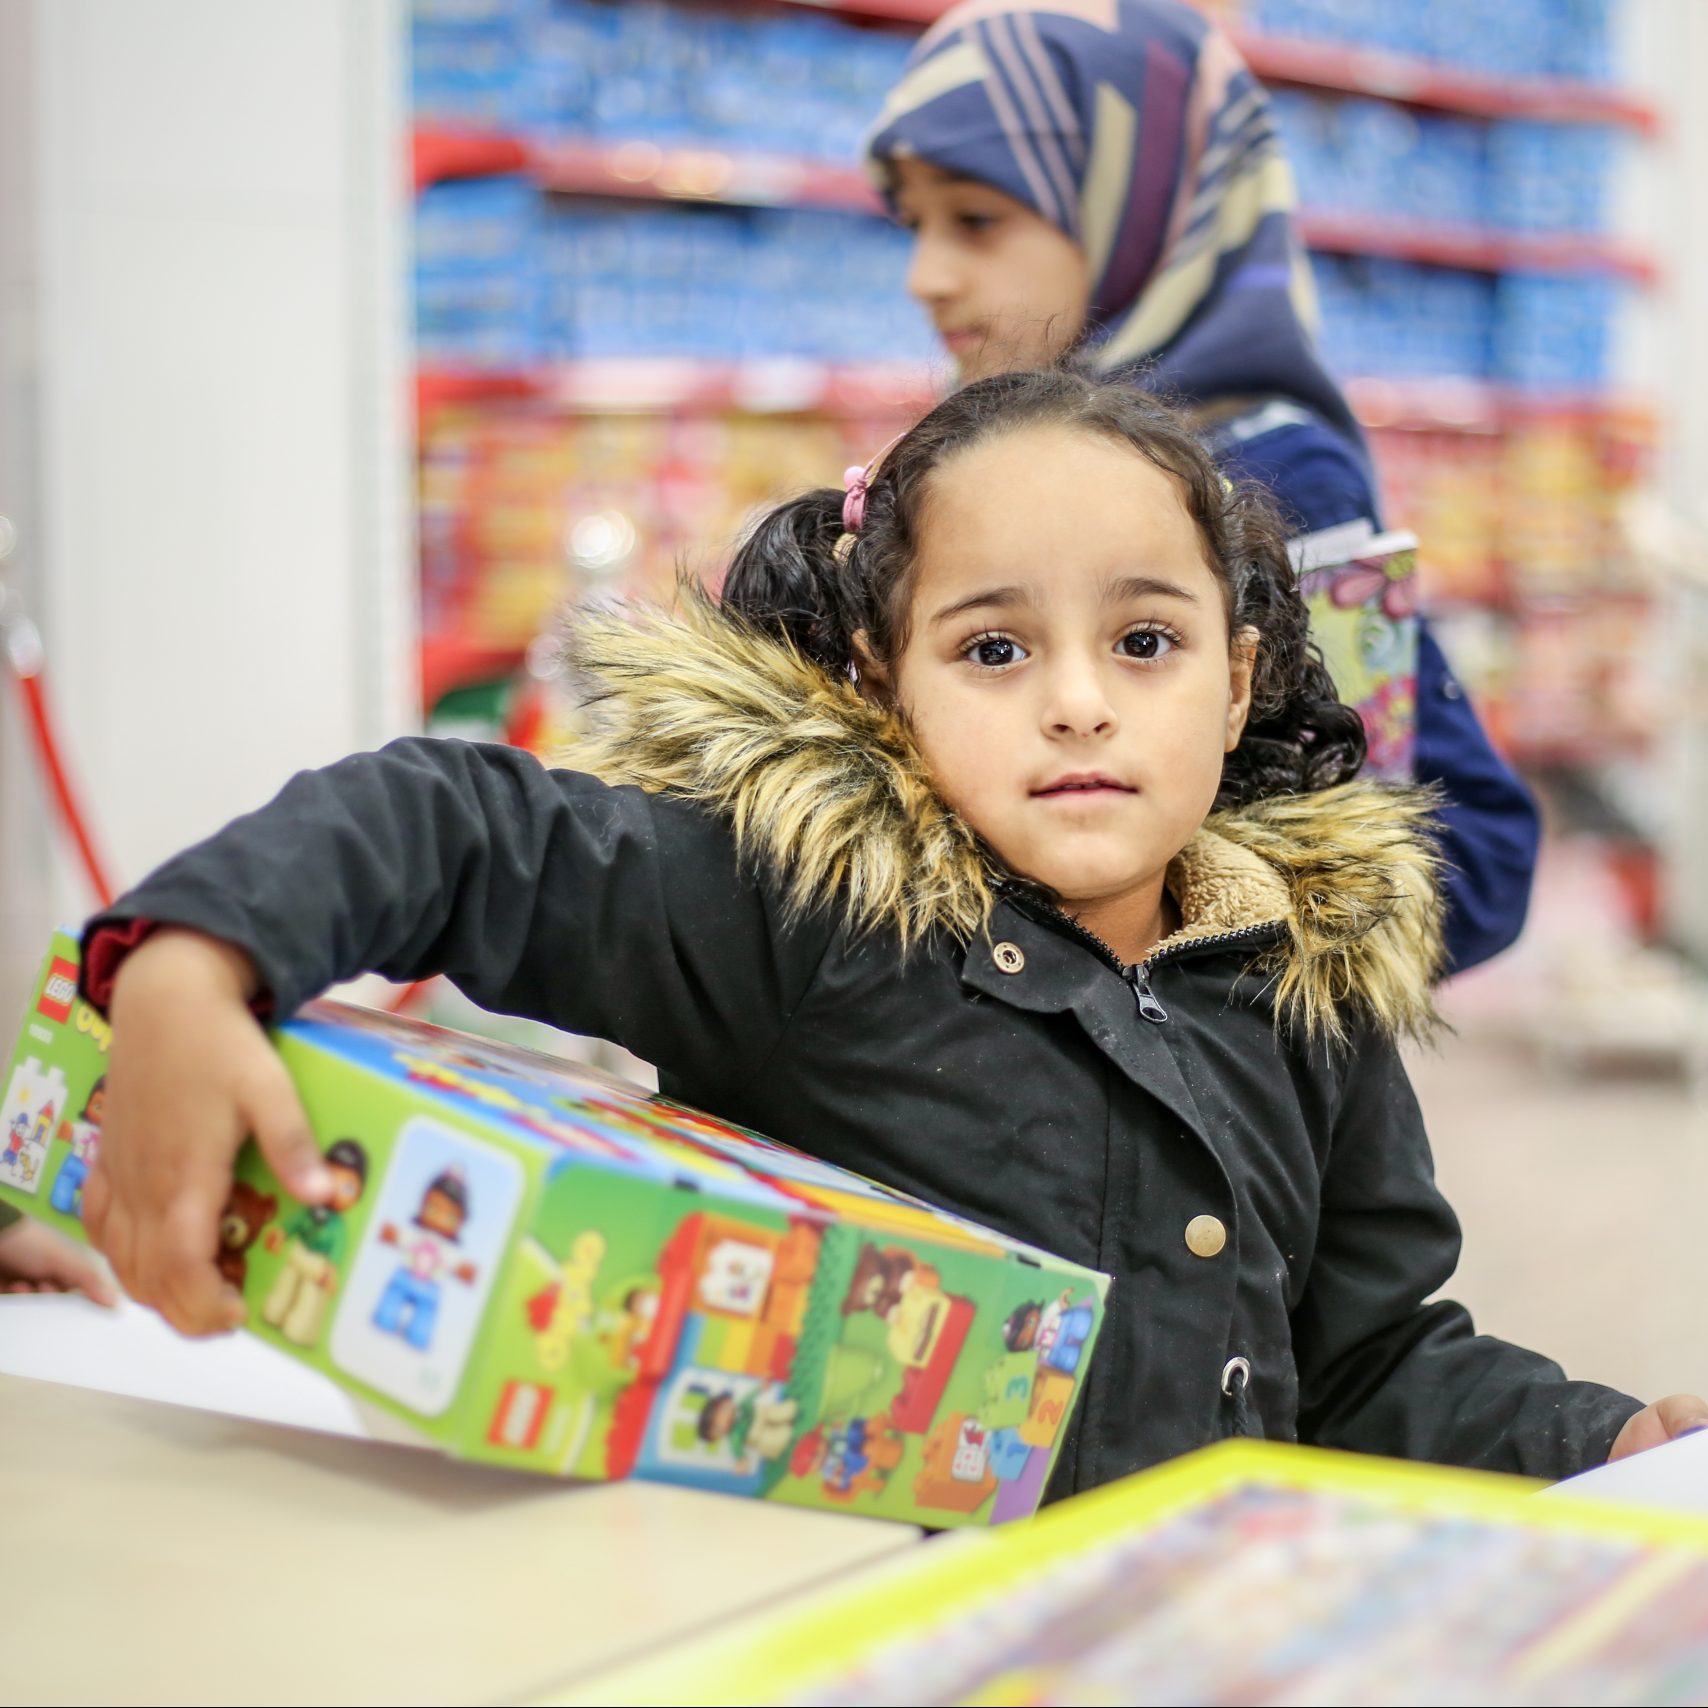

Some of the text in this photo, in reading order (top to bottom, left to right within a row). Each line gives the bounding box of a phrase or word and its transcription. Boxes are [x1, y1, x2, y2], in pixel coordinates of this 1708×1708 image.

[45, 975, 76, 1005] LEGO
[1006, 1376, 1029, 1401] 3
[1038, 1401, 1064, 1425] 2
